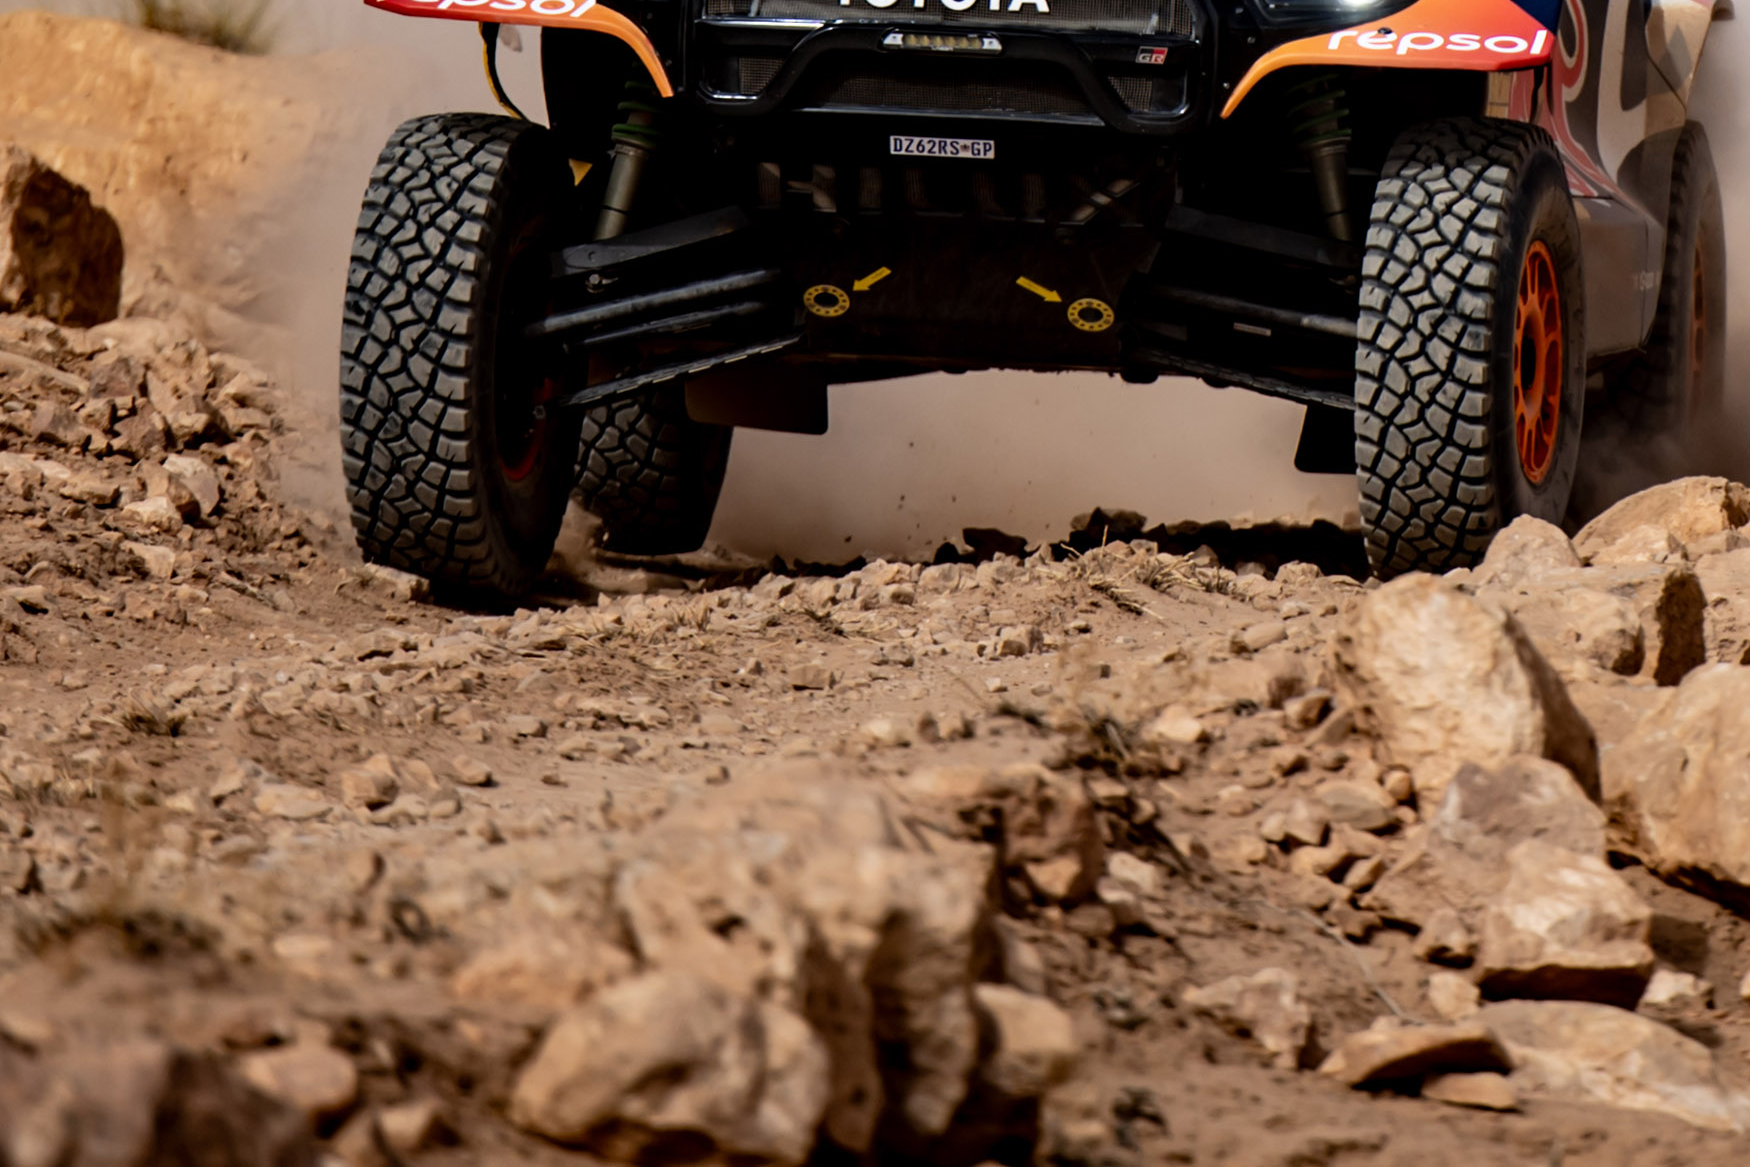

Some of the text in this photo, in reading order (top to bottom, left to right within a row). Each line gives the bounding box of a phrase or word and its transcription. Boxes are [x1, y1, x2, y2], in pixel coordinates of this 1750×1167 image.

[1328, 30, 1548, 55] repsol
[1138, 52, 1166, 64] GR
[893, 137, 993, 157] DZ62RS GP
